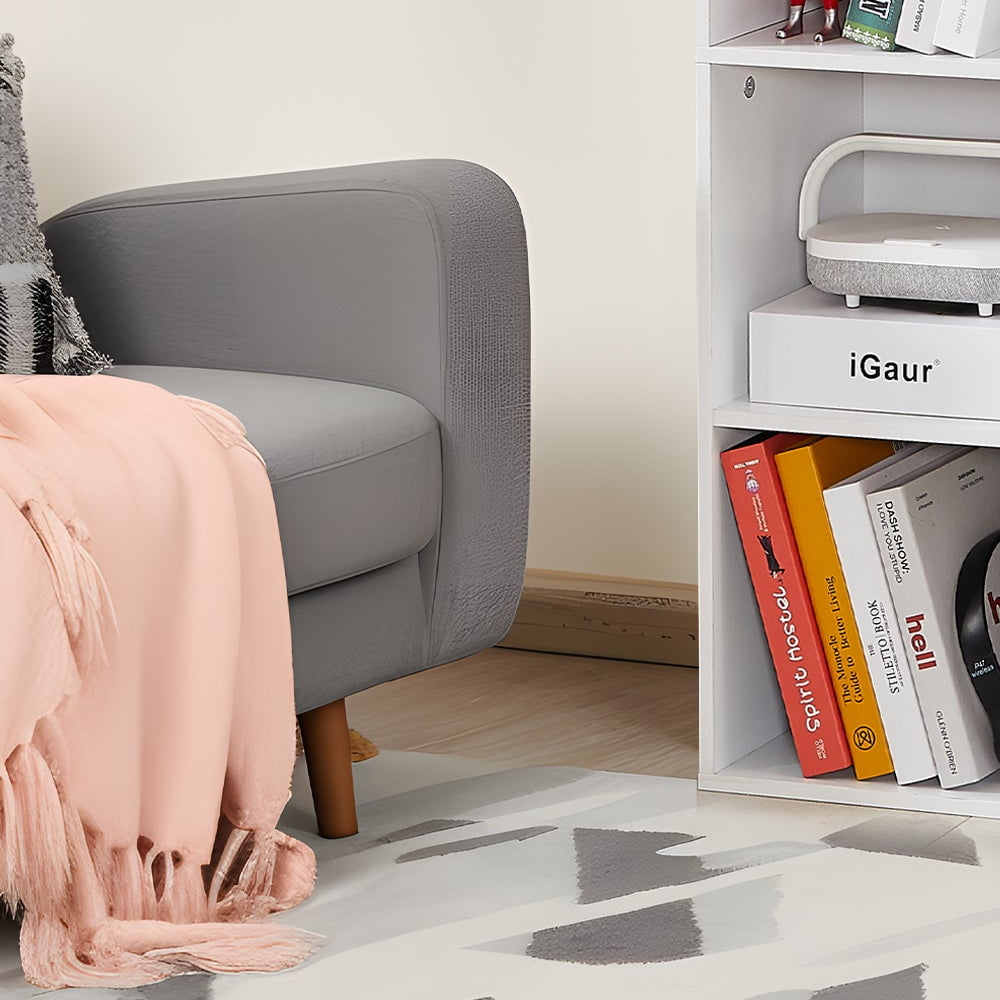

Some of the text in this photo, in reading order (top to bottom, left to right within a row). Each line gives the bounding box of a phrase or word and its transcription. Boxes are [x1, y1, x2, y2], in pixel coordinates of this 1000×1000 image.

[912, 3, 925, 32] MASAO
[878, 507, 888, 530] LOVE
[885, 501, 911, 574] DASH SHOW:
[825, 576, 863, 704] Guide to Better Living
[867, 600, 885, 633] BOOK
[905, 613, 938, 671] hell
[773, 586, 821, 733] Spirit Hostel
[829, 635, 852, 706] The Monocle
[878, 638, 900, 694] STILETTO
[936, 710, 947, 741] GLENN
